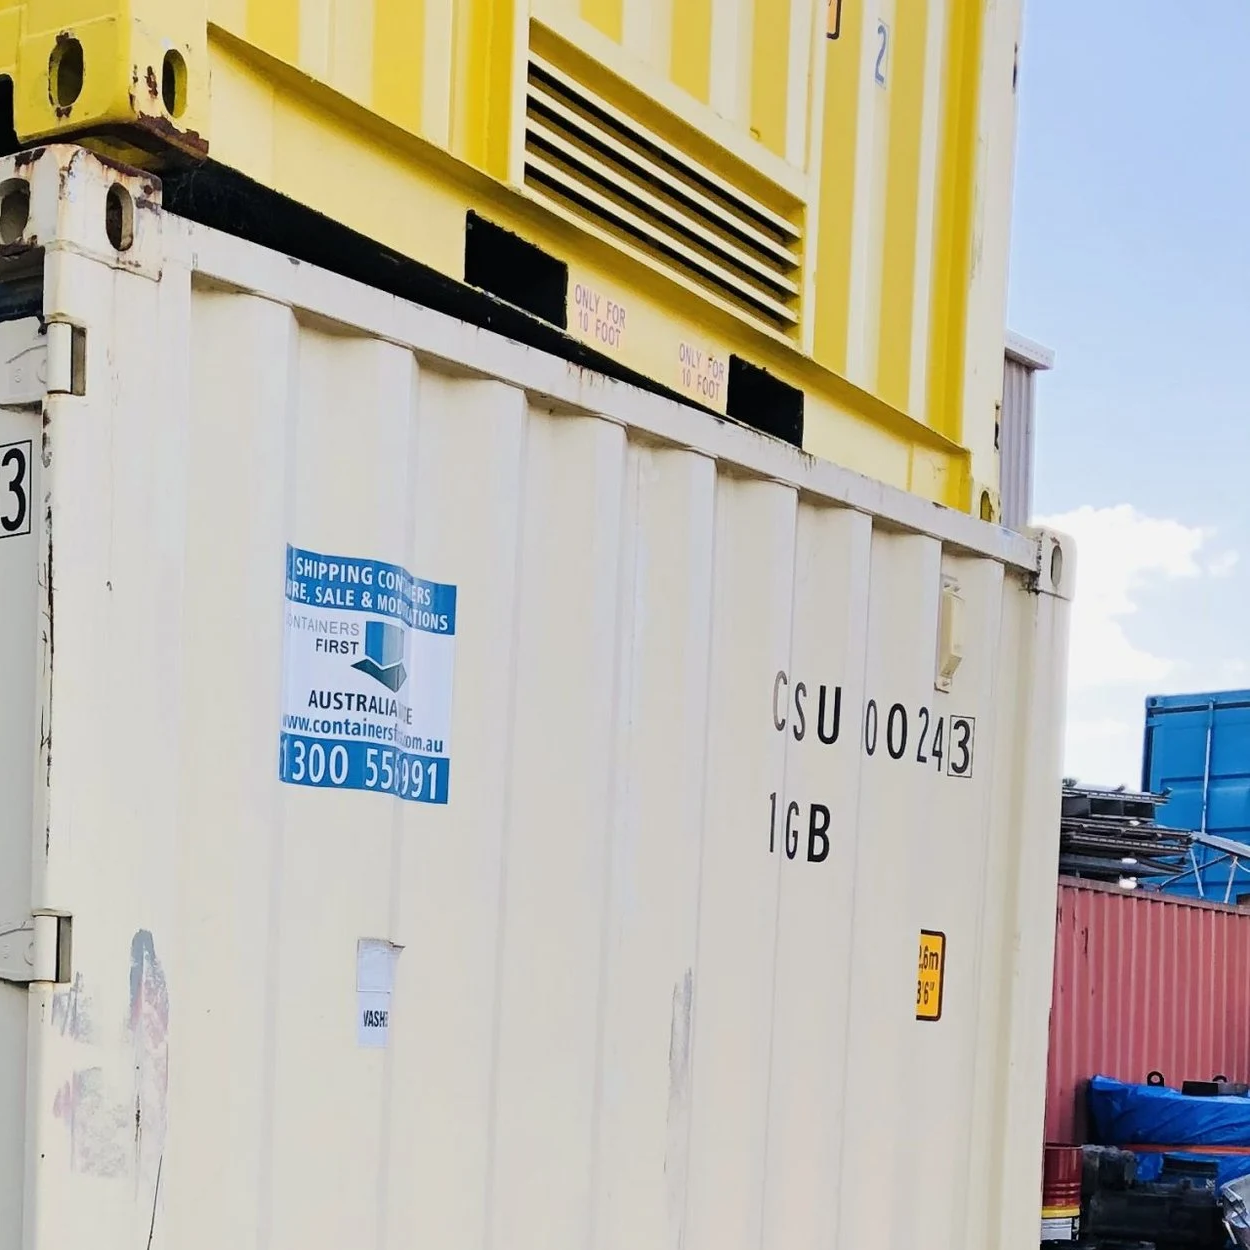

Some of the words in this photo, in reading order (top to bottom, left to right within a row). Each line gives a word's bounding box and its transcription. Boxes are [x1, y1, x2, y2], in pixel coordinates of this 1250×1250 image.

[575, 284, 600, 316] ONLY
[607, 301, 626, 329] FOR
[578, 310, 589, 332] 10
[595, 319, 621, 348] FOOT
[679, 343, 702, 369] ONLY
[708, 356, 724, 380] FOR
[682, 369, 691, 387] 10
[697, 376, 721, 401] FOOT
[1, 448, 27, 532] 3
[296, 557, 373, 585] SHIPPING
[315, 586, 354, 606] SALE
[361, 591, 373, 608] &
[288, 614, 360, 636] ONTAINERS
[316, 638, 359, 655] FIRST
[308, 690, 397, 718] AUSTRALIA
